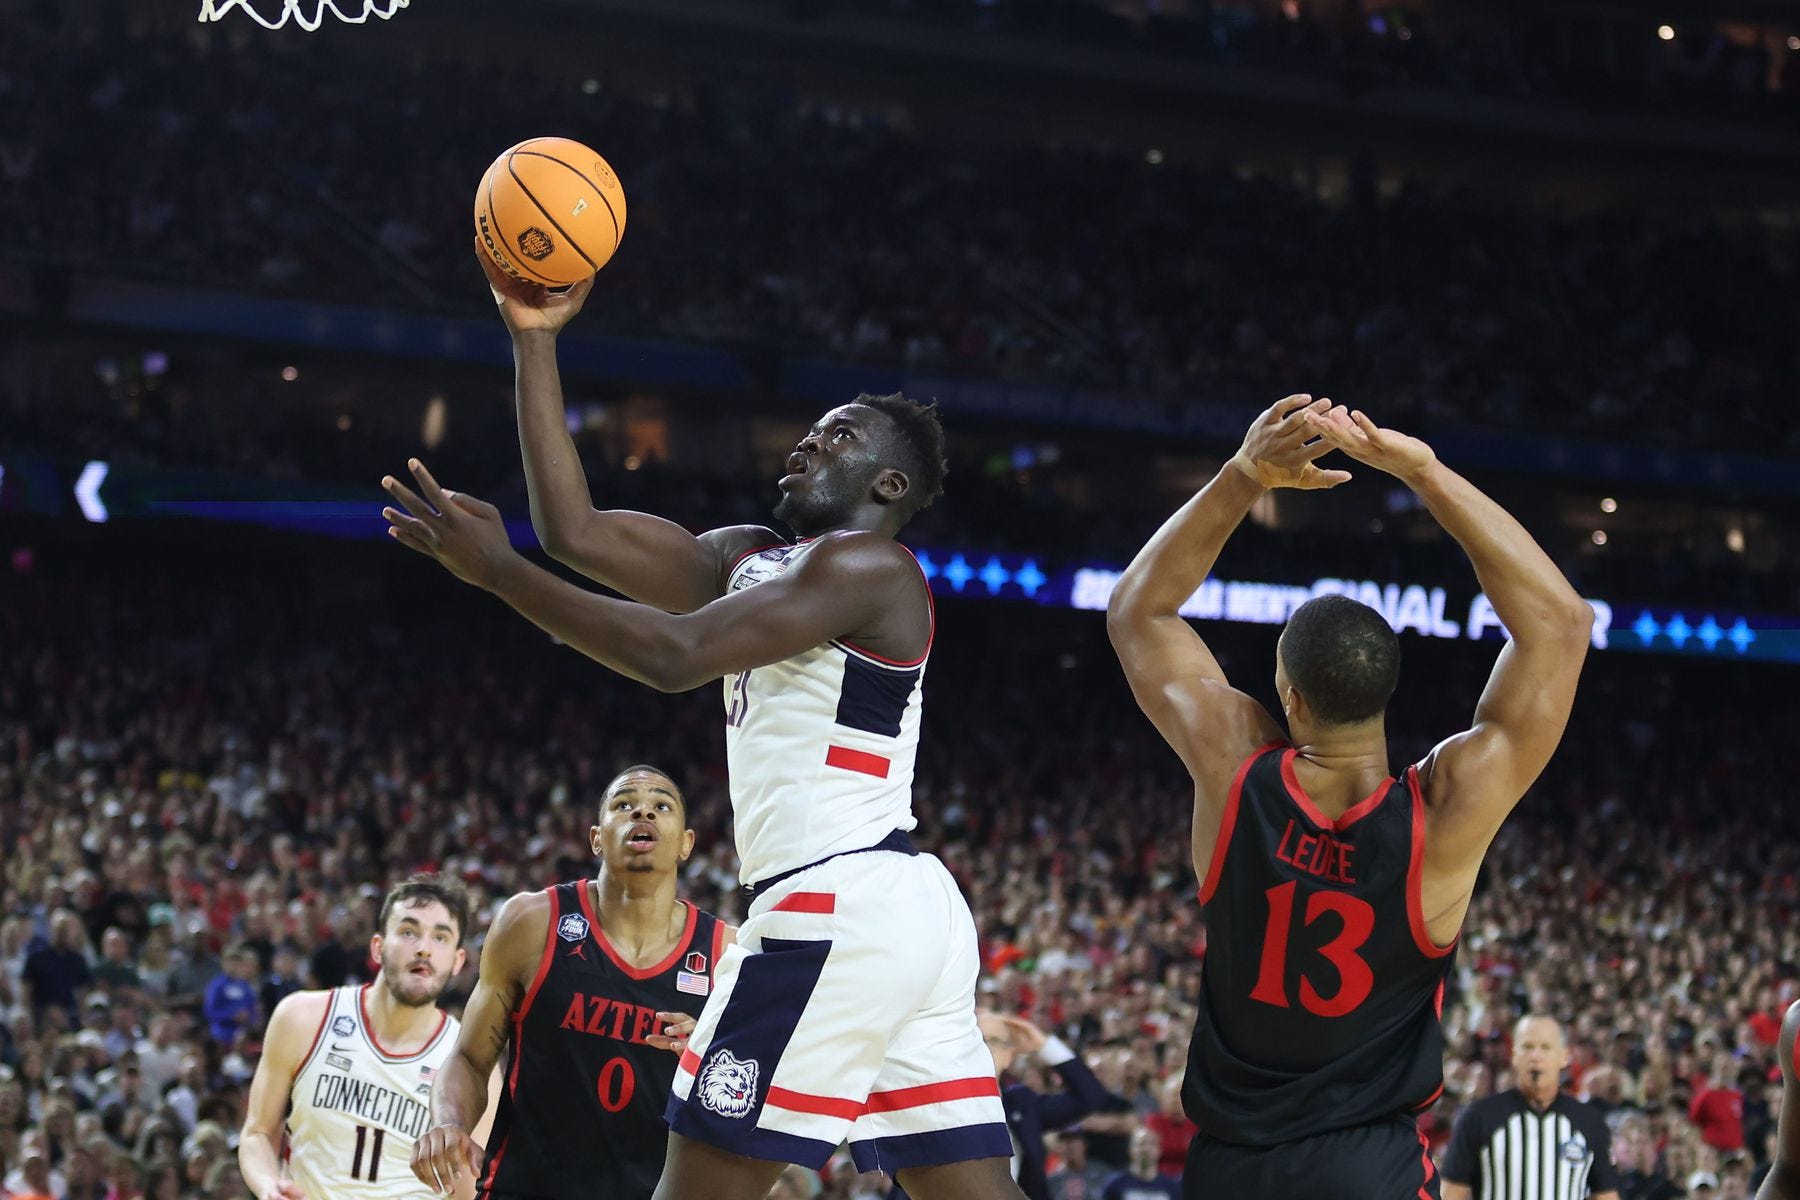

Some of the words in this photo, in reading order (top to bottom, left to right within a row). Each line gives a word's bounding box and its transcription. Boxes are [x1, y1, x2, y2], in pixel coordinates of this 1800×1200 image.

[1466, 592, 1613, 650] FR
[1275, 818, 1357, 885] LEDEE
[1248, 879, 1376, 1019] 13
[560, 992, 689, 1046] AZTE
[597, 1056, 635, 1113] 0
[351, 1125, 386, 1184] 11
